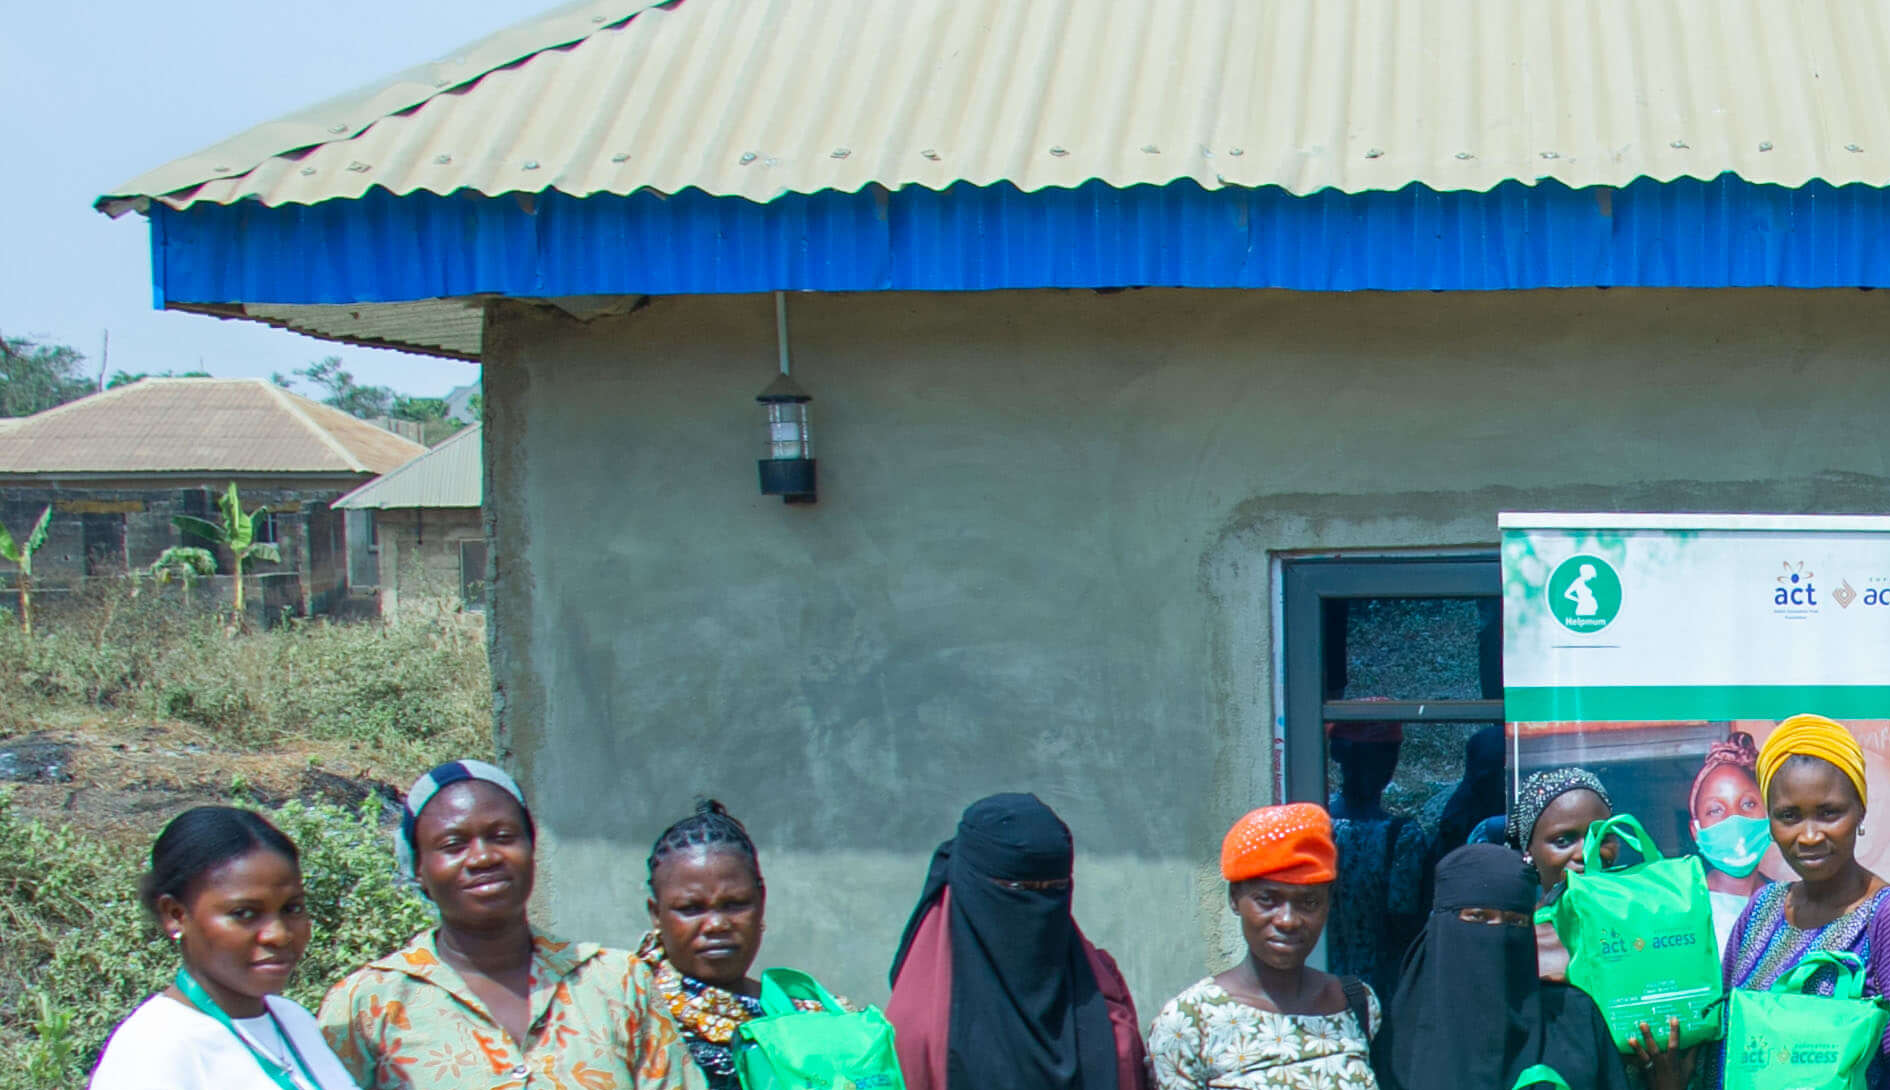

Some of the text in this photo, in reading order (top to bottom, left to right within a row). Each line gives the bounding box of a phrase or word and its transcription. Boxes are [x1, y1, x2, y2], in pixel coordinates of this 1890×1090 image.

[1774, 583, 1817, 606] act
[1602, 932, 1696, 954] act access
[1790, 1049, 1838, 1064] access
